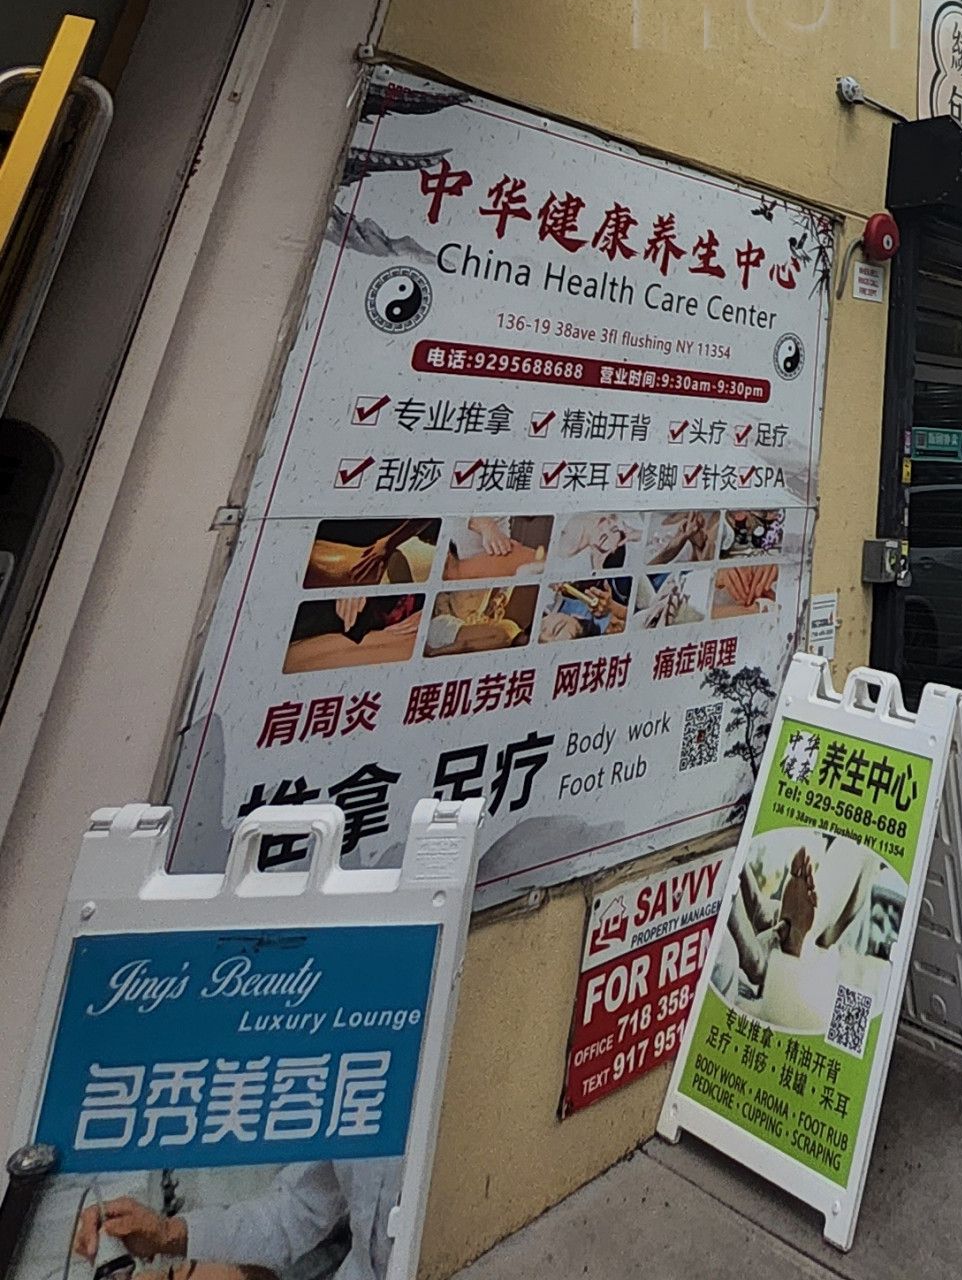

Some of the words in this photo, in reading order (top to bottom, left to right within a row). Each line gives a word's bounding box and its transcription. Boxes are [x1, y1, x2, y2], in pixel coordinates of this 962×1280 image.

[418, 156, 803, 292] 中华健康养生中心
[436, 241, 532, 288] China
[542, 261, 635, 308] Health
[643, 281, 699, 317] Care
[705, 296, 778, 330] Center
[426, 345, 584, 381] 电话:9295688688
[495, 311, 552, 336] 136-19
[554, 319, 597, 343] 38ave
[620, 328, 673, 356] flushing
[675, 337, 694, 355] NY
[697, 342, 732, 360] 11354
[392, 396, 514, 437] 专业推拿
[560, 409, 651, 443] 精油开背
[688, 418, 728, 446] 头疗
[753, 422, 789, 449] 足疗
[374, 455, 445, 493] 刮痧
[476, 459, 536, 493] 拔罐
[562, 461, 612, 492] 采耳
[636, 462, 679, 492] 修脚
[700, 463, 738, 491] 针灸
[755, 466, 785, 490] SPA
[256, 690, 383, 750] 肩周炎
[402, 666, 536, 726] 腰肌劳损
[551, 652, 632, 701] 网球肘
[652, 636, 739, 683] 痛症调理
[564, 727, 616, 757] Body
[627, 712, 672, 742] work
[788, 729, 821, 758] 中华
[558, 767, 604, 800] Foot
[610, 754, 648, 785] Rub
[778, 753, 815, 787] 健康
[817, 740, 918, 813] 养生中心
[776, 779, 803, 803] Tel:
[804, 789, 909, 840] 929-5688-688
[829, 820, 863, 846] Flushing
[863, 832, 878, 849] NY
[878, 837, 906, 859] 11354
[633, 859, 723, 927] SAVVY
[630, 916, 680, 949] PROPERTY
[86, 957, 191, 1016] Jing's
[200, 954, 324, 1008] Beauty
[582, 953, 651, 1027] FOR
[237, 1010, 327, 1035] Luxury
[332, 1006, 422, 1030] Lounge
[573, 1033, 614, 1068] OFFICE
[616, 1005, 652, 1043] 718
[725, 1007, 775, 1049] 专业推拿
[784, 1037, 843, 1085] 精油开背
[581, 1067, 611, 1097] TEXT
[612, 1038, 649, 1082] 917
[705, 1024, 733, 1055] 足疗
[740, 1043, 769, 1074] 刮痧
[778, 1064, 808, 1097] 拔罐
[818, 1085, 851, 1120] 采耳
[691, 1072, 735, 1110] PEDICURE
[741, 1101, 783, 1139] CUPPING
[790, 1129, 842, 1171] SCRAPING
[694, 1053, 720, 1081] BODY
[719, 1067, 748, 1095] WORK
[753, 1087, 790, 1118] AROMA
[797, 1111, 827, 1138] FOOT
[827, 1126, 849, 1152] RUB
